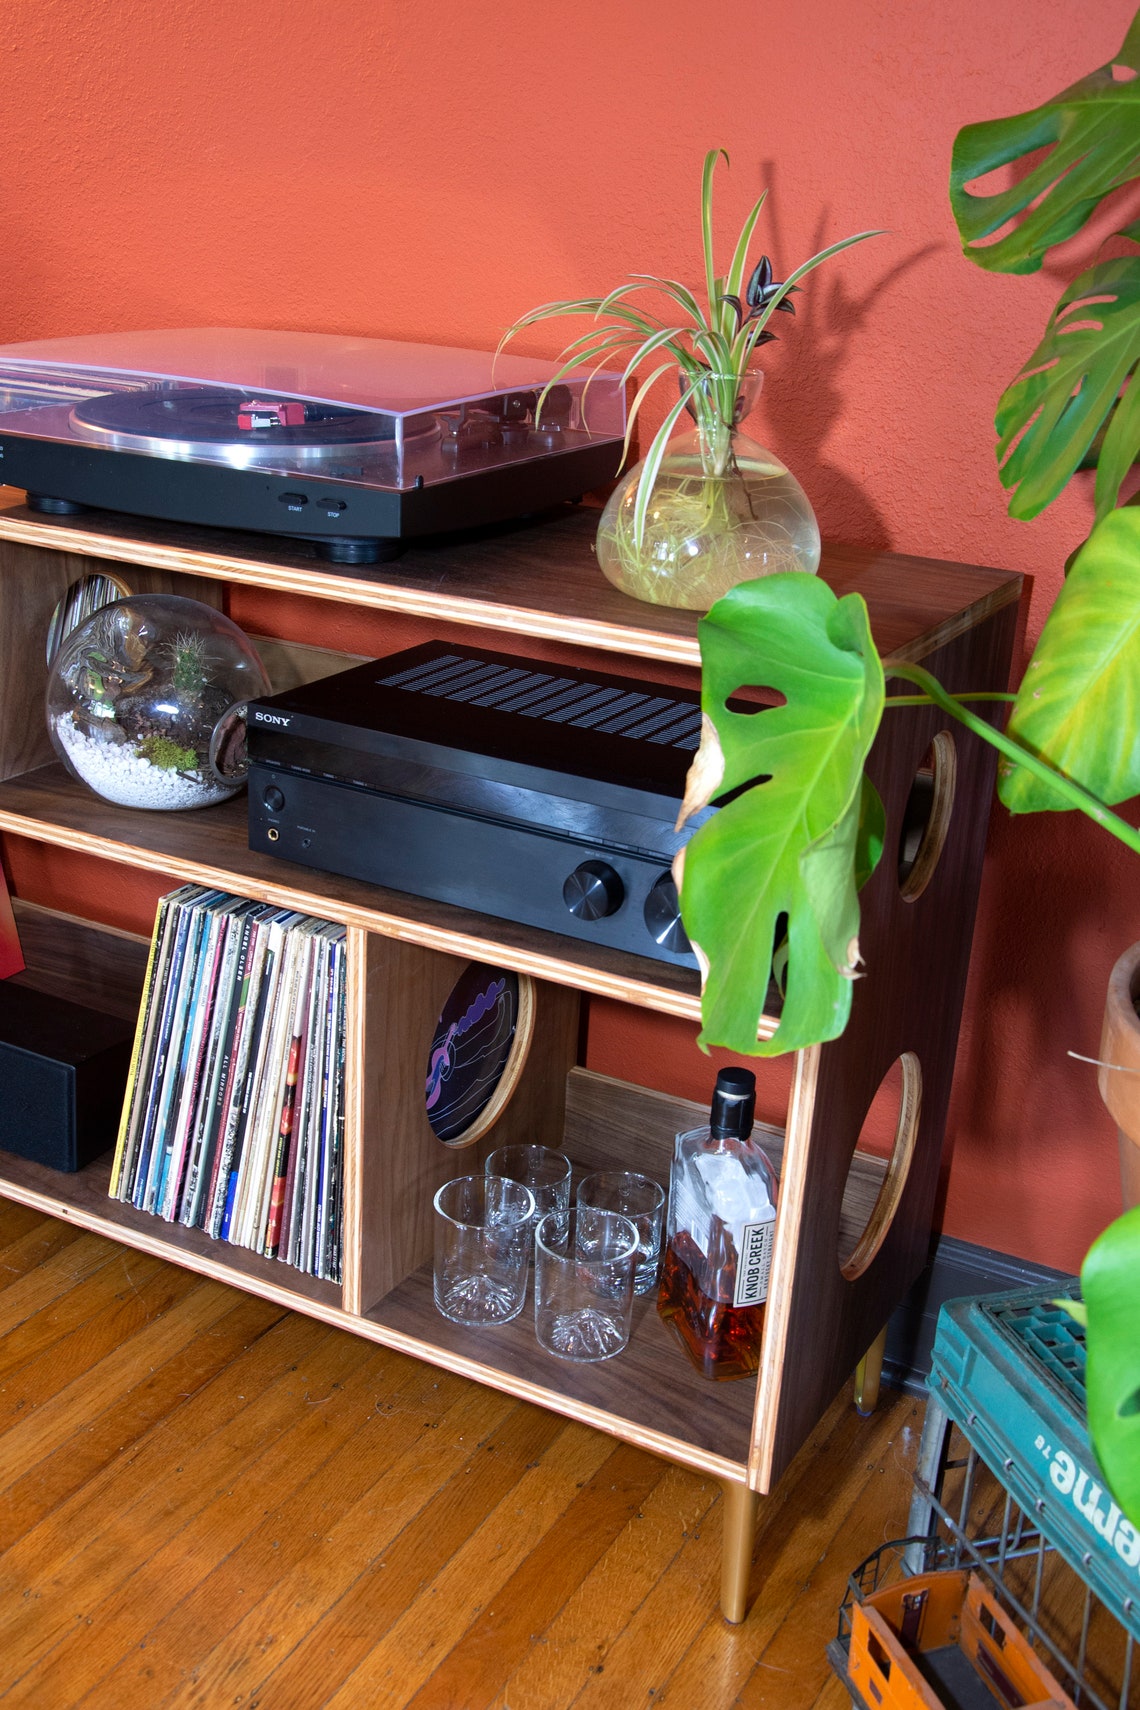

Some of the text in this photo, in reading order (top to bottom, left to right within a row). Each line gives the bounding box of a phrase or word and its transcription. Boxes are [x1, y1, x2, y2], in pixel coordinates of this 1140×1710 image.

[255, 712, 291, 727] SONY
[236, 924, 250, 981] ANGEL OLSEN
[216, 1072, 226, 1105] MIRRORS
[745, 1227, 765, 1299] KNOB CREEK
[1050, 1450, 1140, 1572] erne
